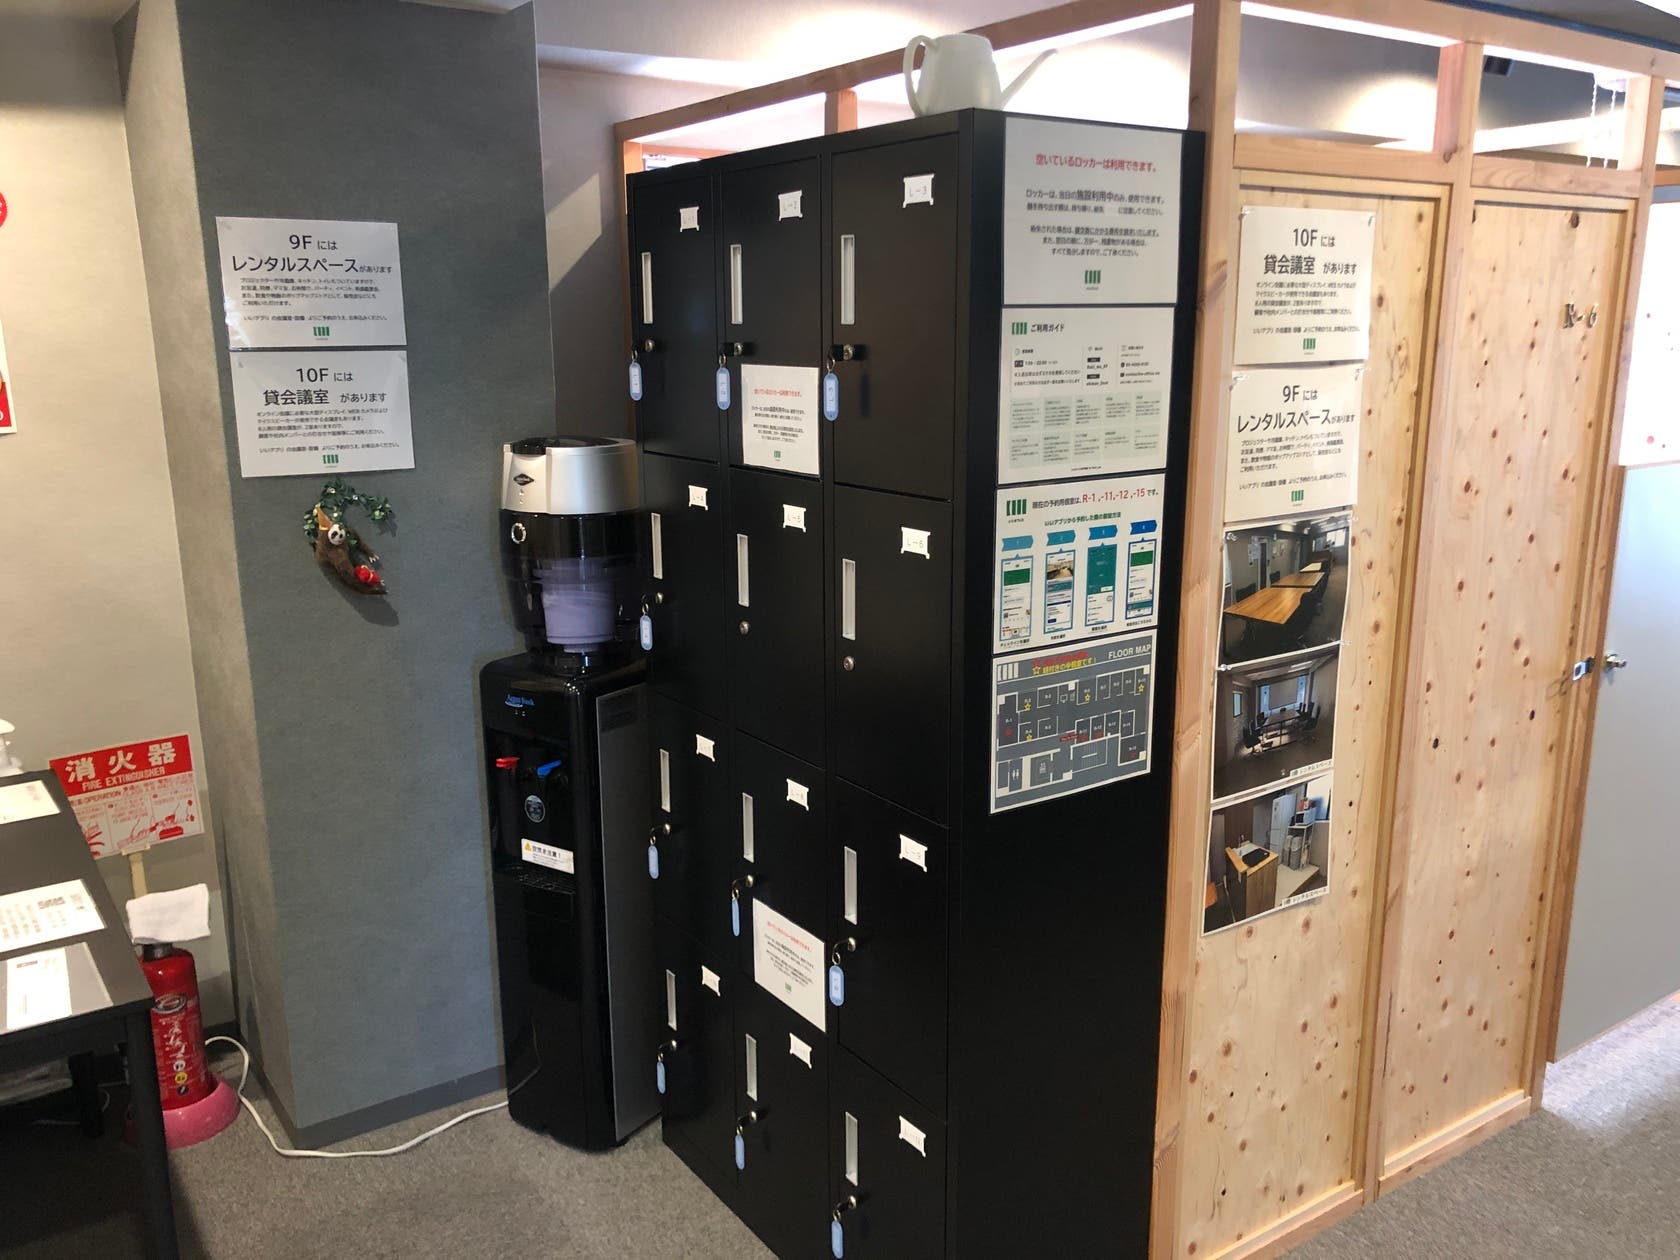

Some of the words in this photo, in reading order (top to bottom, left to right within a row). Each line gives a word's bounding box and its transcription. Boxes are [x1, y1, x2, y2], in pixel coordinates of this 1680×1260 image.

[289, 234, 312, 250] 9F
[317, 240, 338, 251] には
[1293, 229, 1318, 247] 10F
[1321, 236, 1336, 248] には
[1264, 254, 1316, 275] 貸会議室
[1323, 263, 1357, 275] があります
[1030, 323, 1065, 334] ご利用ガイド
[296, 368, 329, 383] 10F
[333, 372, 354, 382] には
[264, 389, 329, 406] 貸会議室
[340, 393, 387, 403] があります
[1283, 385, 1300, 404] 9F
[1303, 390, 1318, 401] には
[1108, 647, 1134, 660] FLOOR
[1135, 644, 1152, 655] MAP
[65, 741, 177, 783] 消火器
[82, 778, 103, 792] FIRE
[105, 765, 166, 787] EXTINGUISHER
